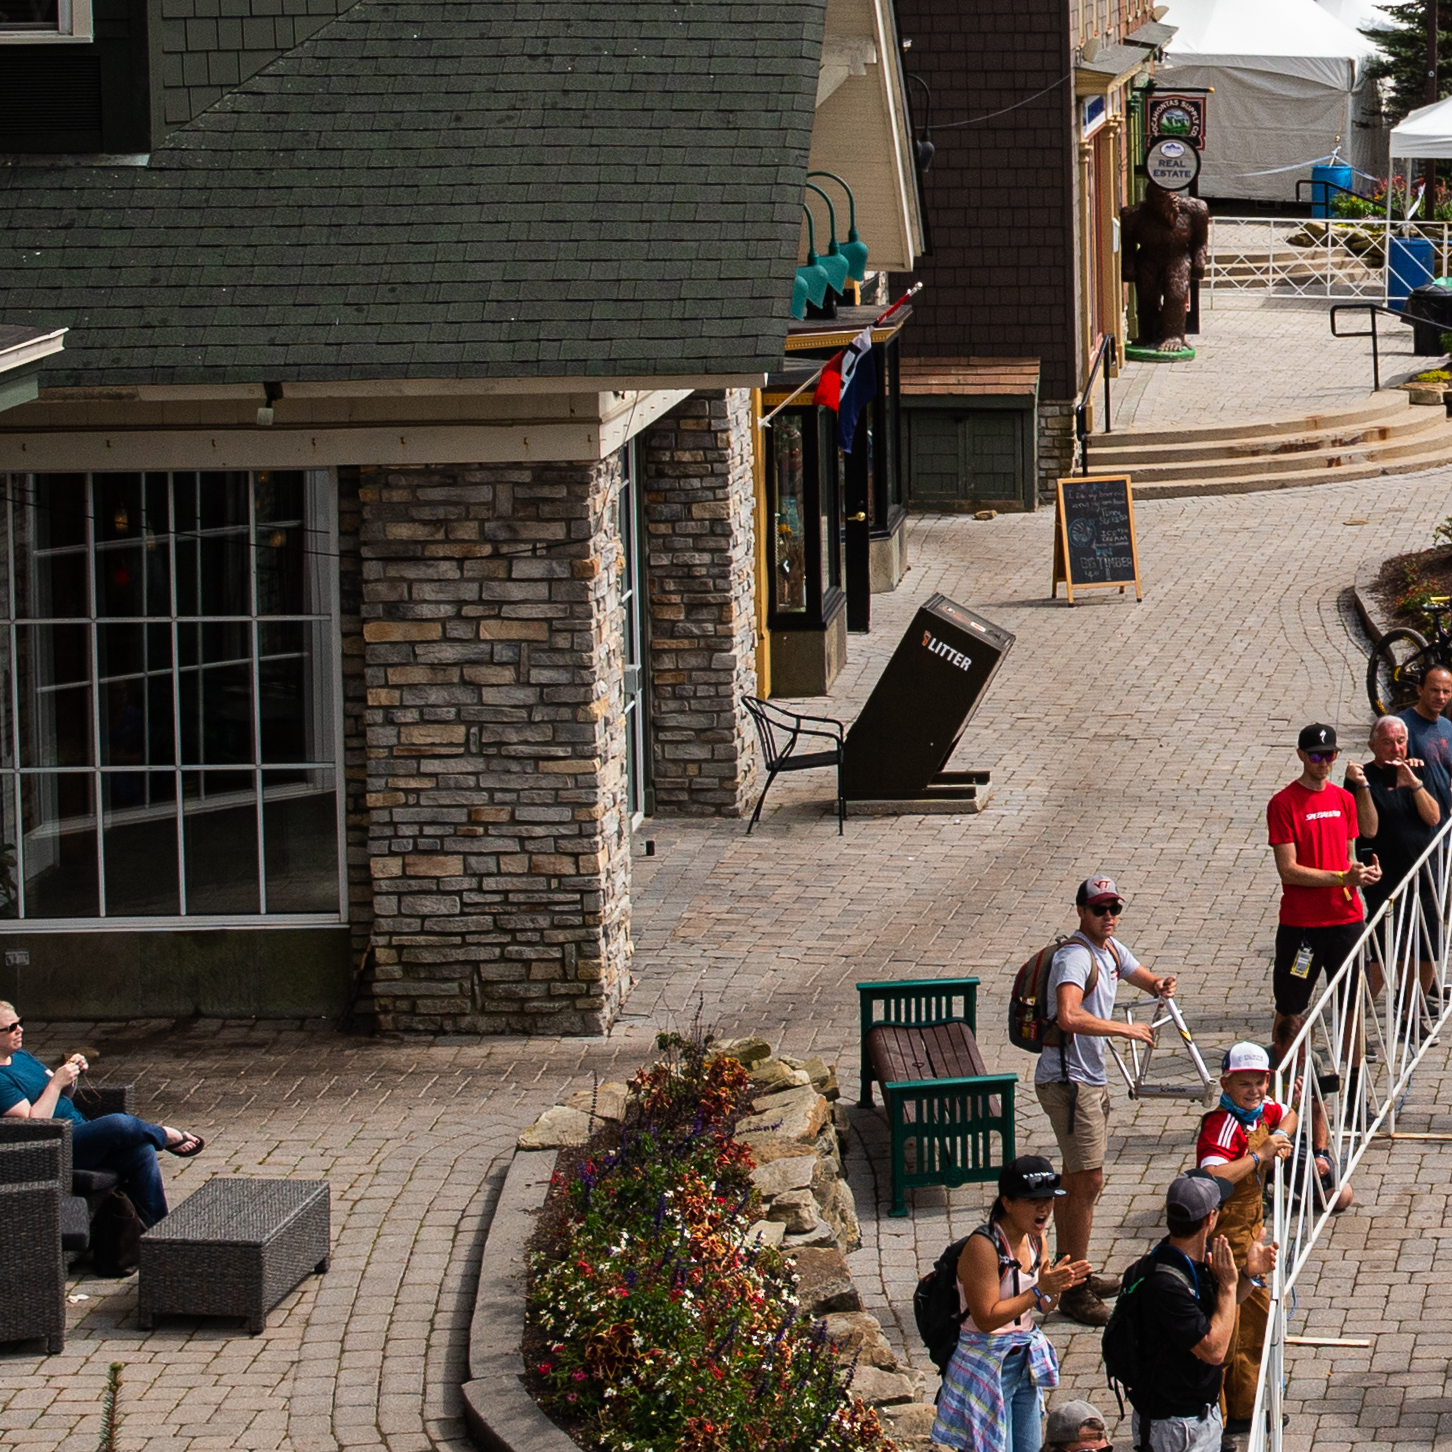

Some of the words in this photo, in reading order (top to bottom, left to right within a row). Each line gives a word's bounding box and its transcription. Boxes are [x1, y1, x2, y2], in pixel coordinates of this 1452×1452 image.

[1152, 99, 1179, 136] OCAHONTAS
[1181, 101, 1200, 125] SUPPLY
[1153, 169, 1191, 178] ESTATE
[1158, 159, 1186, 168] REAL
[928, 637, 972, 672] LITTER
